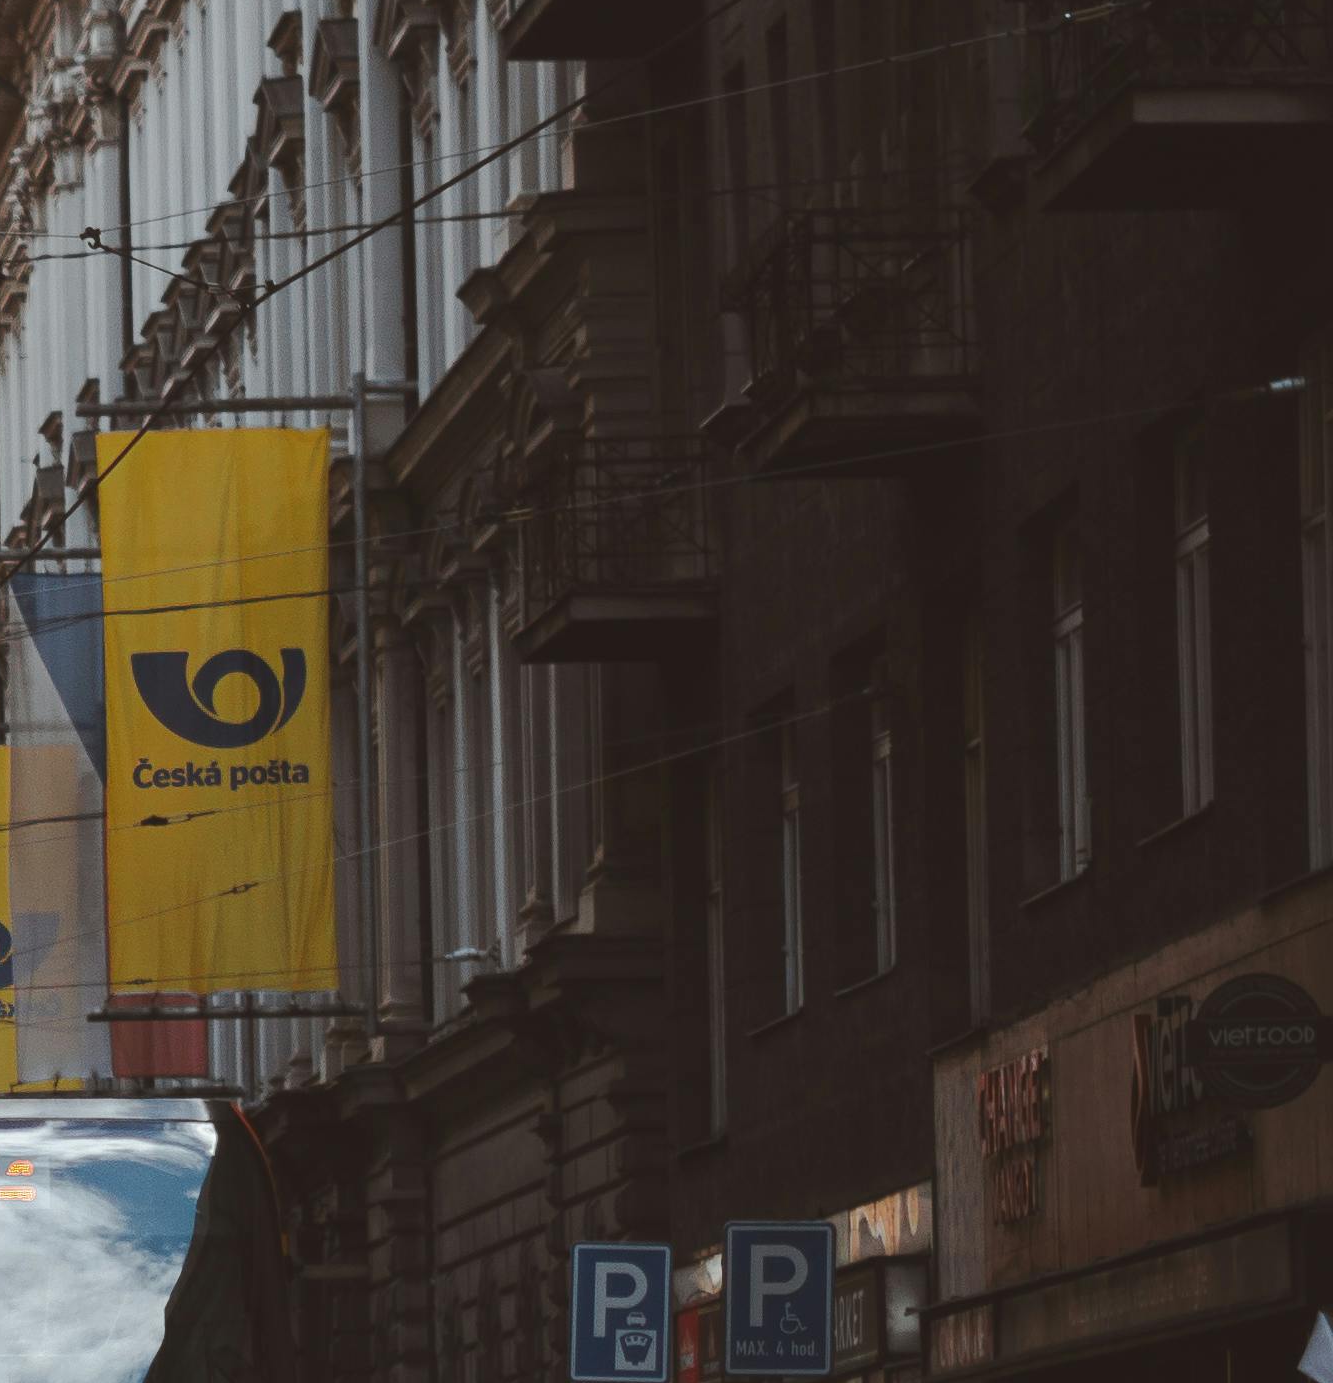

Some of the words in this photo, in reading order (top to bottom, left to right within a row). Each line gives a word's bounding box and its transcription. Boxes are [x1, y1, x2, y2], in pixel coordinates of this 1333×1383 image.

[132, 757, 222, 789] Česká
[229, 759, 310, 792] pošta
[593, 1261, 649, 1338] P
[749, 1243, 809, 1328] P
[735, 1339, 768, 1357] MAX.
[790, 1340, 819, 1357] hod.
[834, 1289, 866, 1352] ARKET
